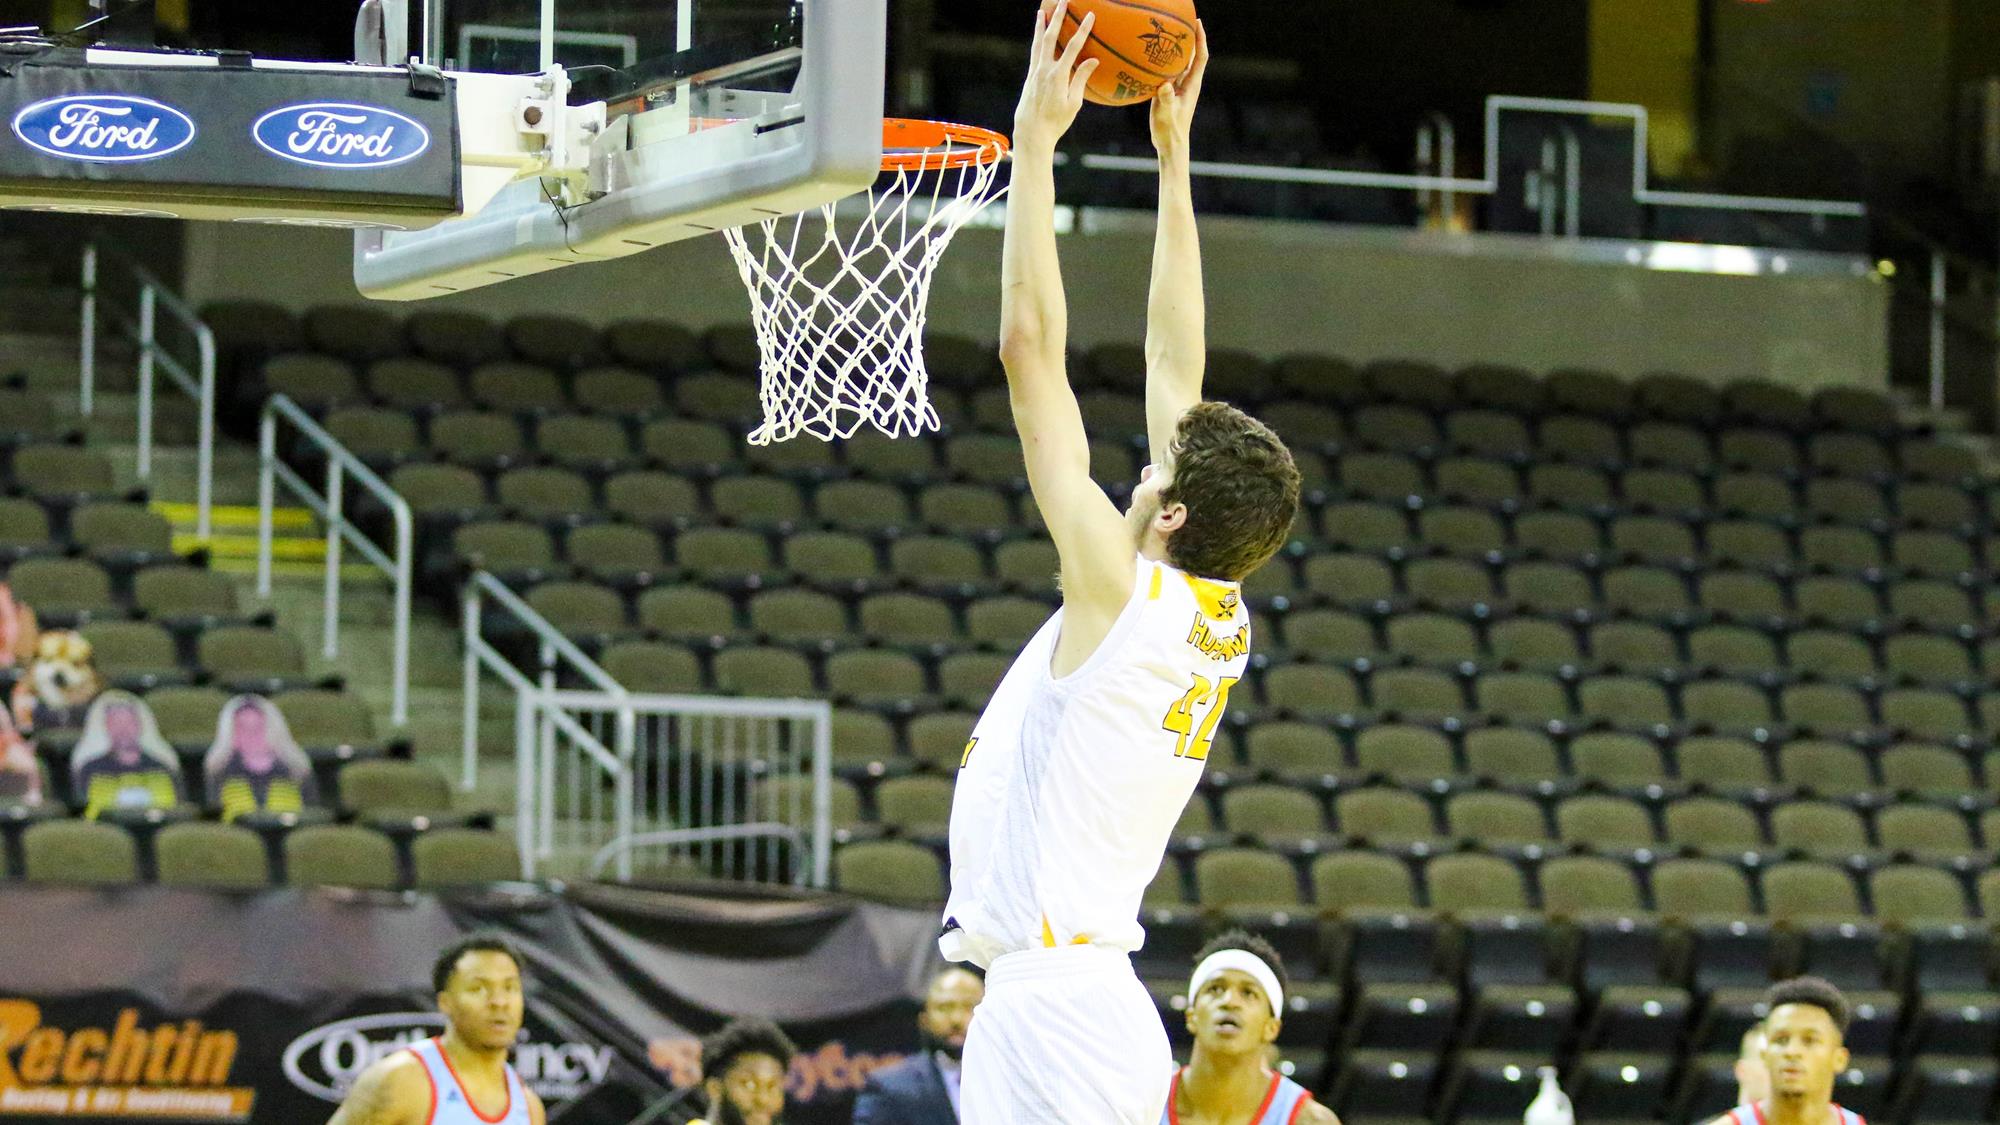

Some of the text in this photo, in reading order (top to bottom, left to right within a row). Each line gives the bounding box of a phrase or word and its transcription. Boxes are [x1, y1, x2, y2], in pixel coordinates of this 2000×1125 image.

[49, 103, 158, 150] Ford
[287, 110, 394, 158] Ford
[1162, 672, 1238, 761] 42
